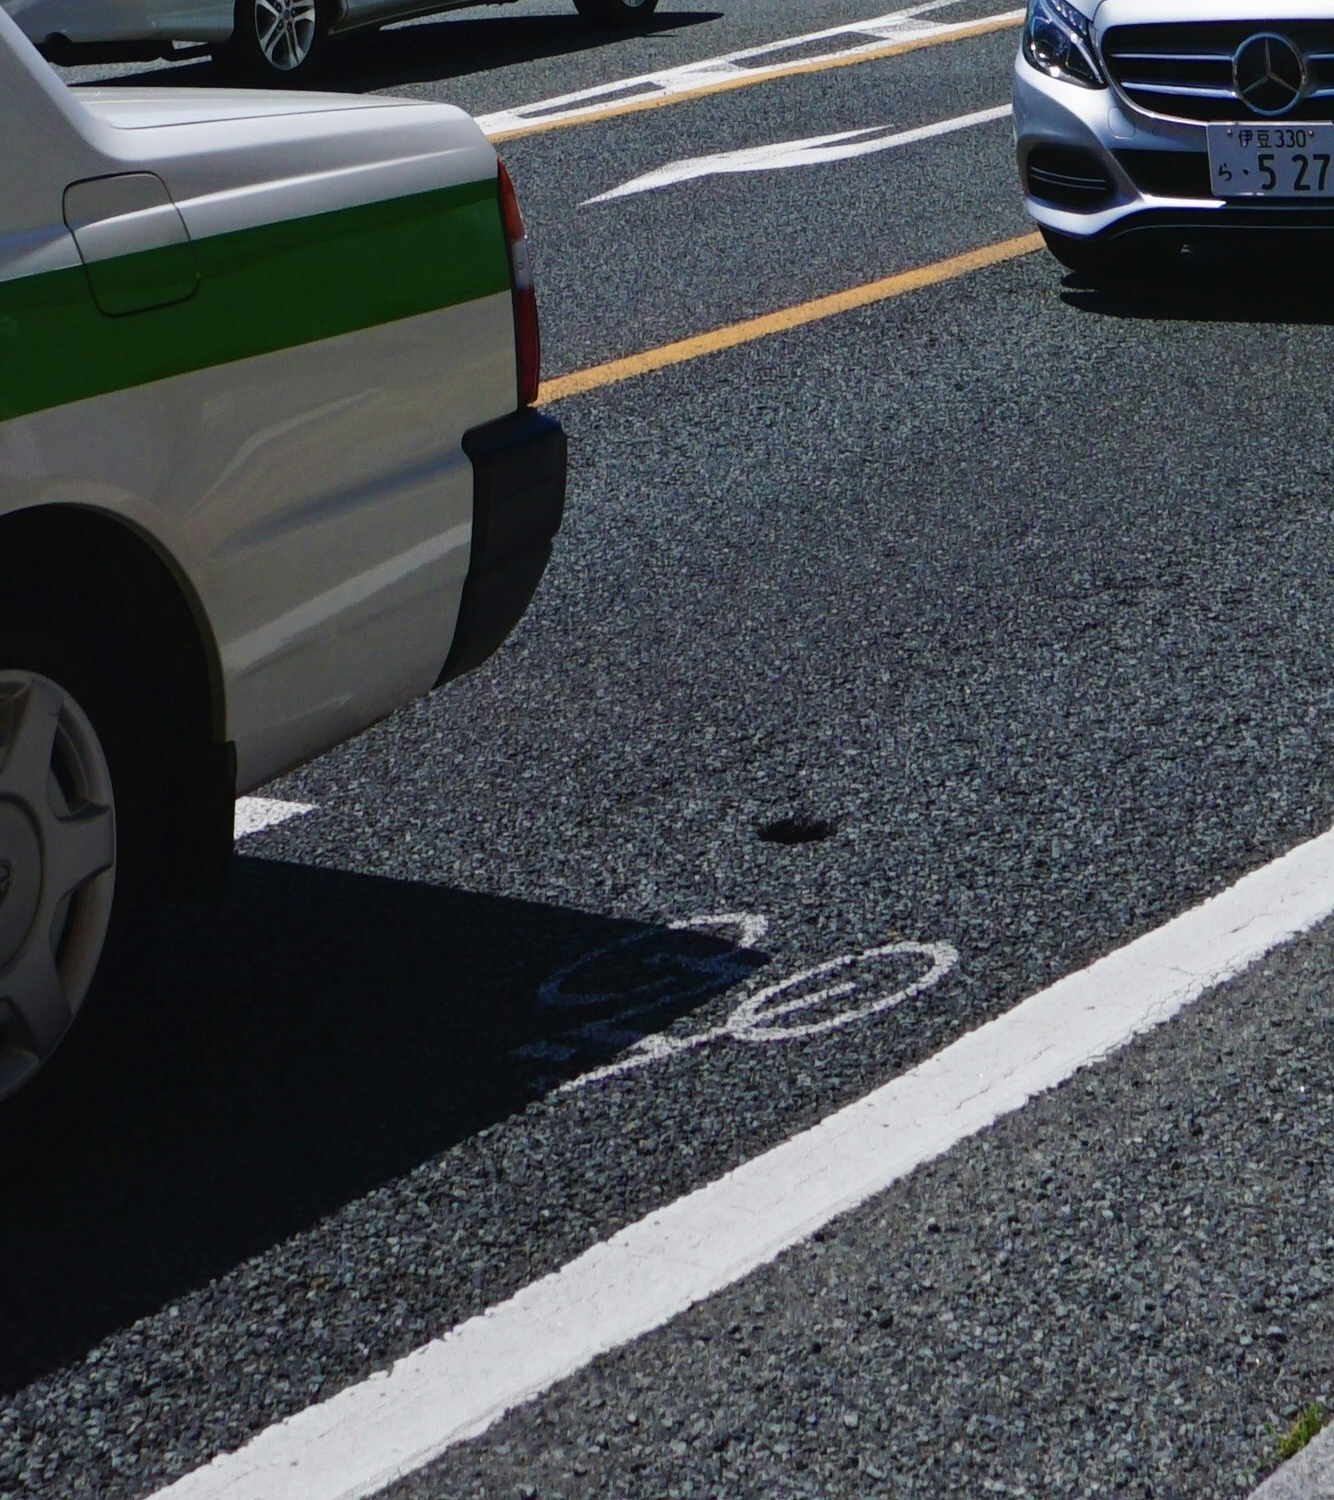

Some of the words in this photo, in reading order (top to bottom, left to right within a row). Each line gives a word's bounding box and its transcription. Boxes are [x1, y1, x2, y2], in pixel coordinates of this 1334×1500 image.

[1238, 129, 1272, 148] 伊豆
[1275, 129, 1306, 148] 330
[1218, 162, 1232, 181] ら
